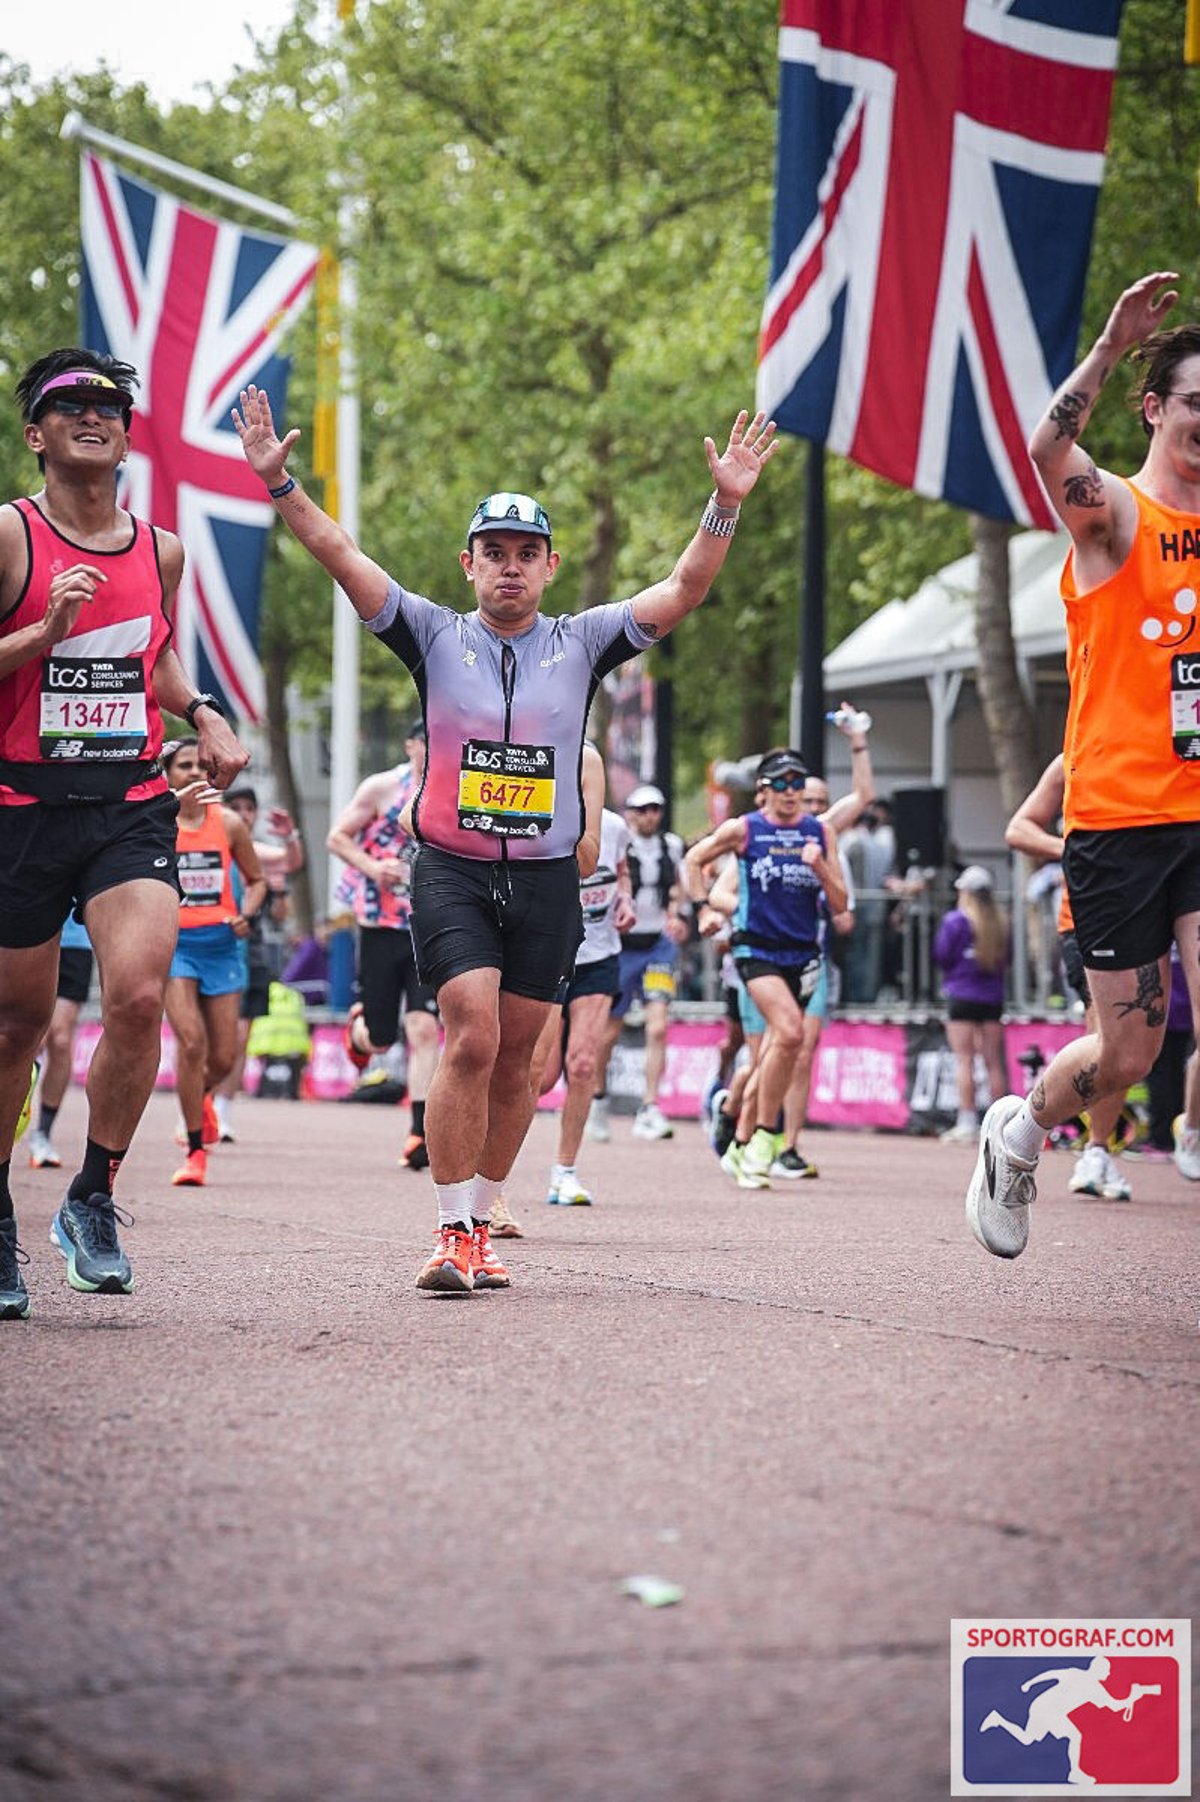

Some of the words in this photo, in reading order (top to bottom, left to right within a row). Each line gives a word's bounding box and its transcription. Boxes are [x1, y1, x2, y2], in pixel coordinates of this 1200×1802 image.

[1160, 528, 1200, 562] HA
[49, 663, 88, 688] tcs
[91, 663, 114, 671] TATA
[91, 671, 139, 680] CONSULTANCY
[91, 680, 124, 689] SERVICES
[59, 702, 130, 728] 13477
[83, 750, 102, 758] new
[103, 748, 139, 758] balance
[480, 781, 536, 809] 6477
